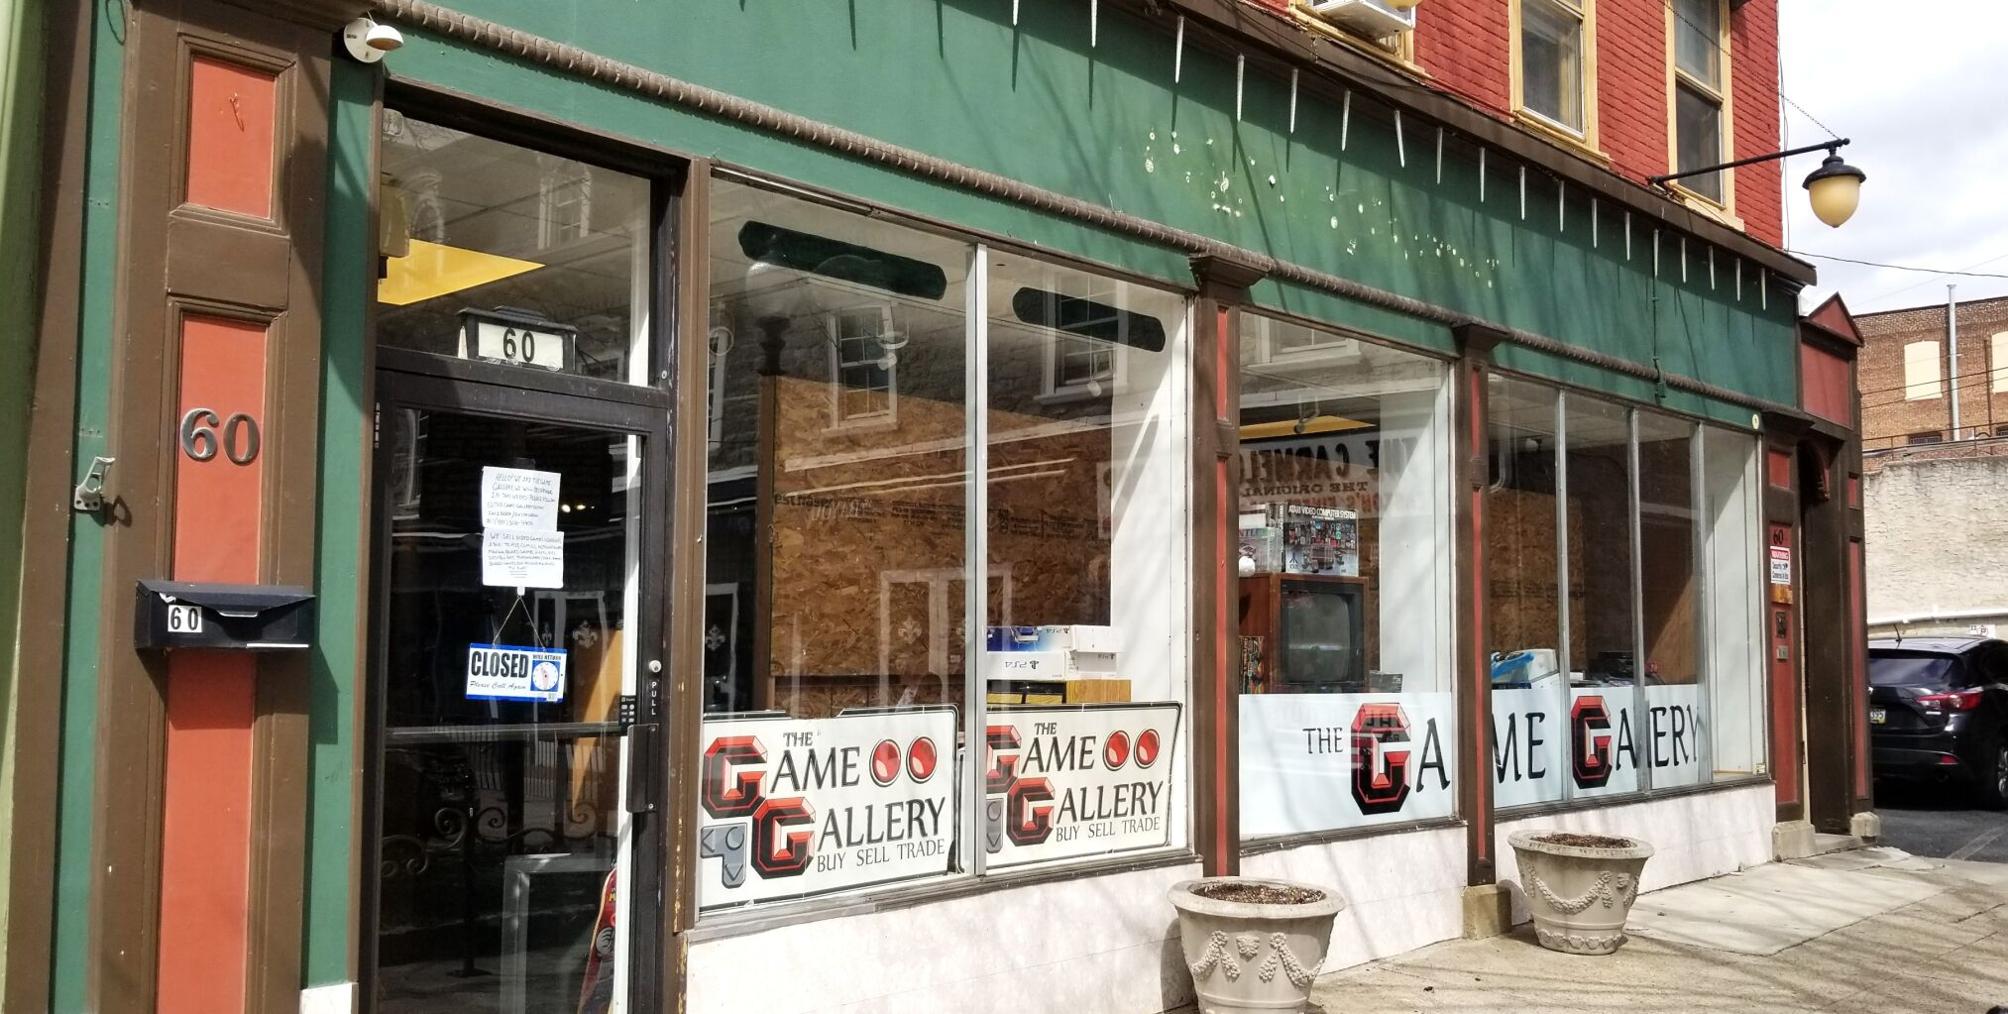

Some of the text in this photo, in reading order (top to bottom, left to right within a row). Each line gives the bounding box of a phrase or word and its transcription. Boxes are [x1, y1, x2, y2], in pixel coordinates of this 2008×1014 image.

[502, 327, 535, 363] 60
[181, 407, 261, 467] 60
[1301, 506, 1316, 516] VIDEO
[1316, 508, 1340, 518] COMPUTER
[1339, 510, 1356, 519] SYSTEM
[1773, 529, 1783, 545] 60
[170, 607, 199, 631] 60
[471, 650, 529, 679] CLOSED
[1005, 661, 1028, 669] PS4
[783, 731, 813, 748] THE
[1034, 722, 1057, 736] THE
[1303, 727, 1343, 754] THE
[701, 735, 861, 820] GAME
[1006, 777, 1164, 847] GALLERY
[751, 796, 946, 880] GALLERY
[1056, 816, 1161, 843] BUY SELL TRADE
[817, 839, 946, 873] BUY SELL TRADE
